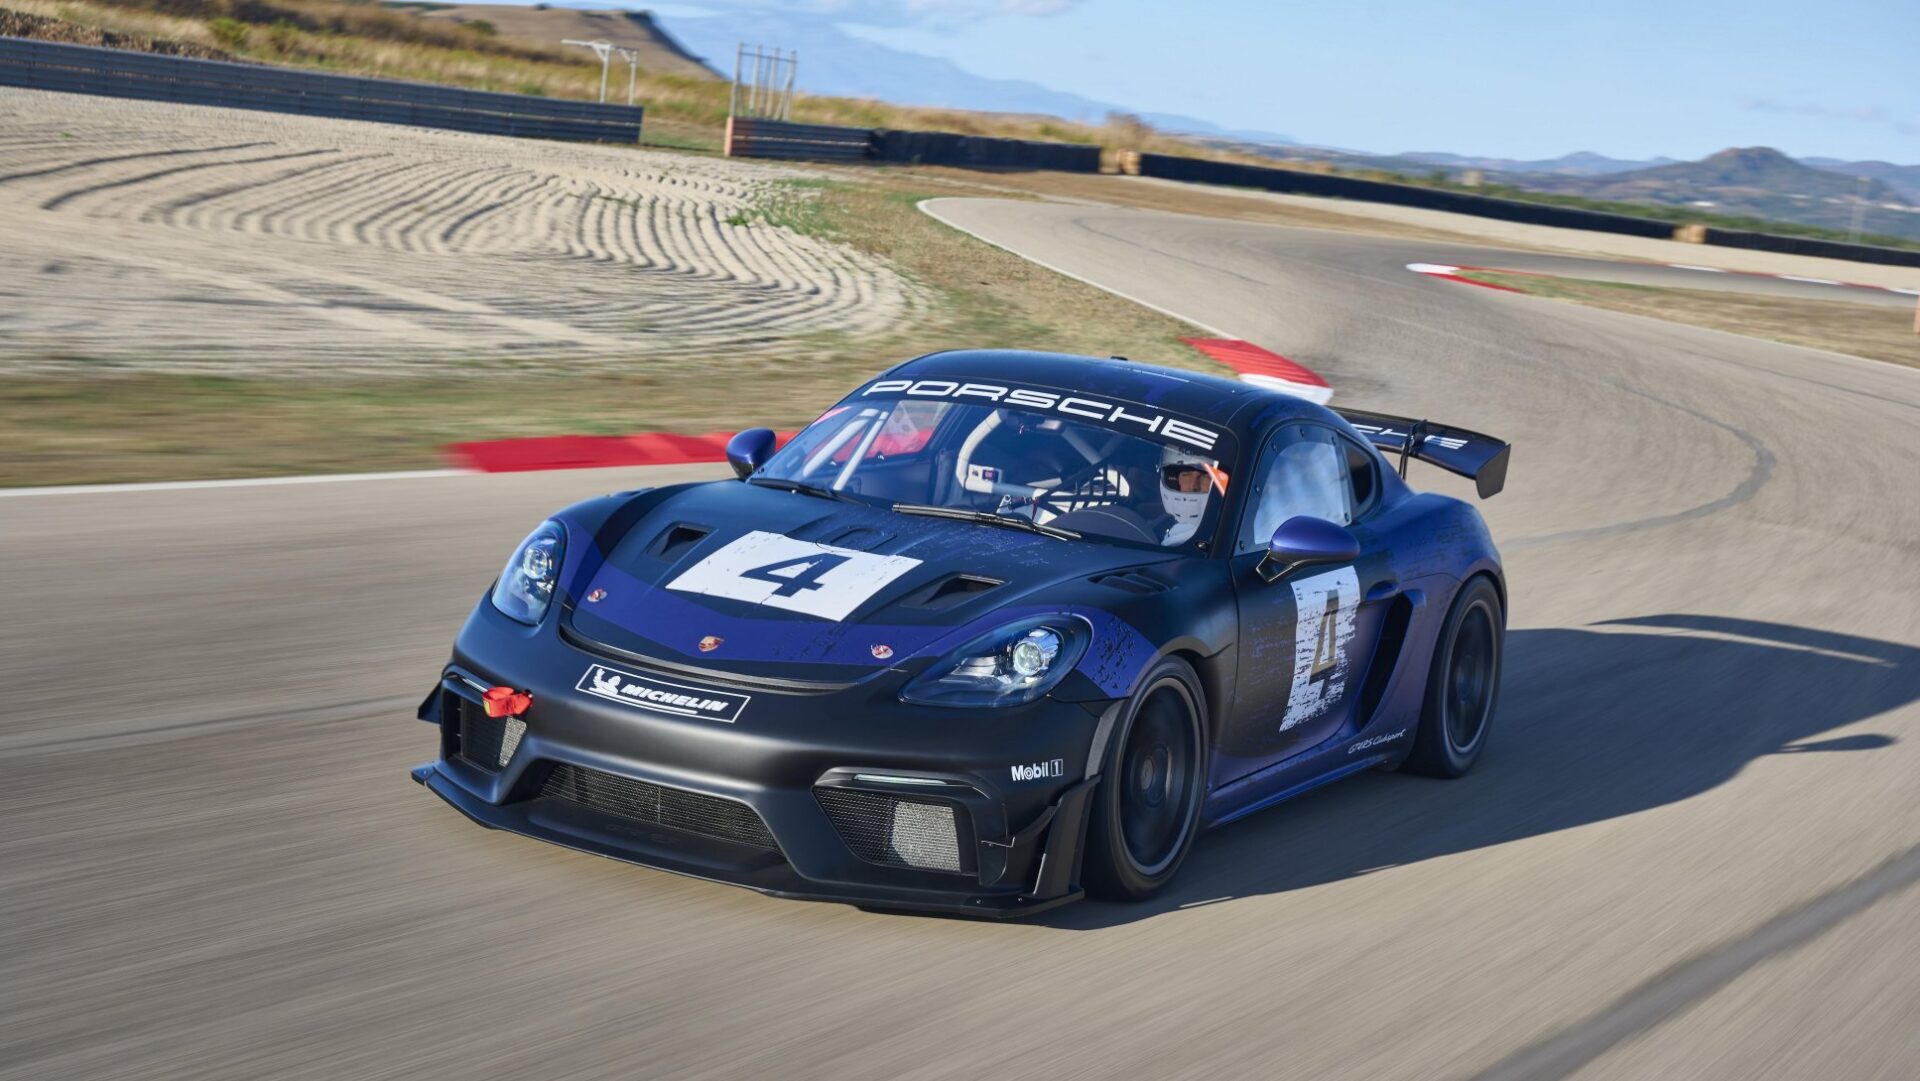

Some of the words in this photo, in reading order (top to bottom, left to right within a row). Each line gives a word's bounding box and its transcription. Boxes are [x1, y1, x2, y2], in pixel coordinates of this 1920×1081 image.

[862, 380, 1219, 450] PORSCHE
[739, 552, 853, 598] 4
[1309, 589, 1344, 700] 4
[620, 683, 729, 712] MICHELIN
[1011, 761, 1049, 781] Mobil
